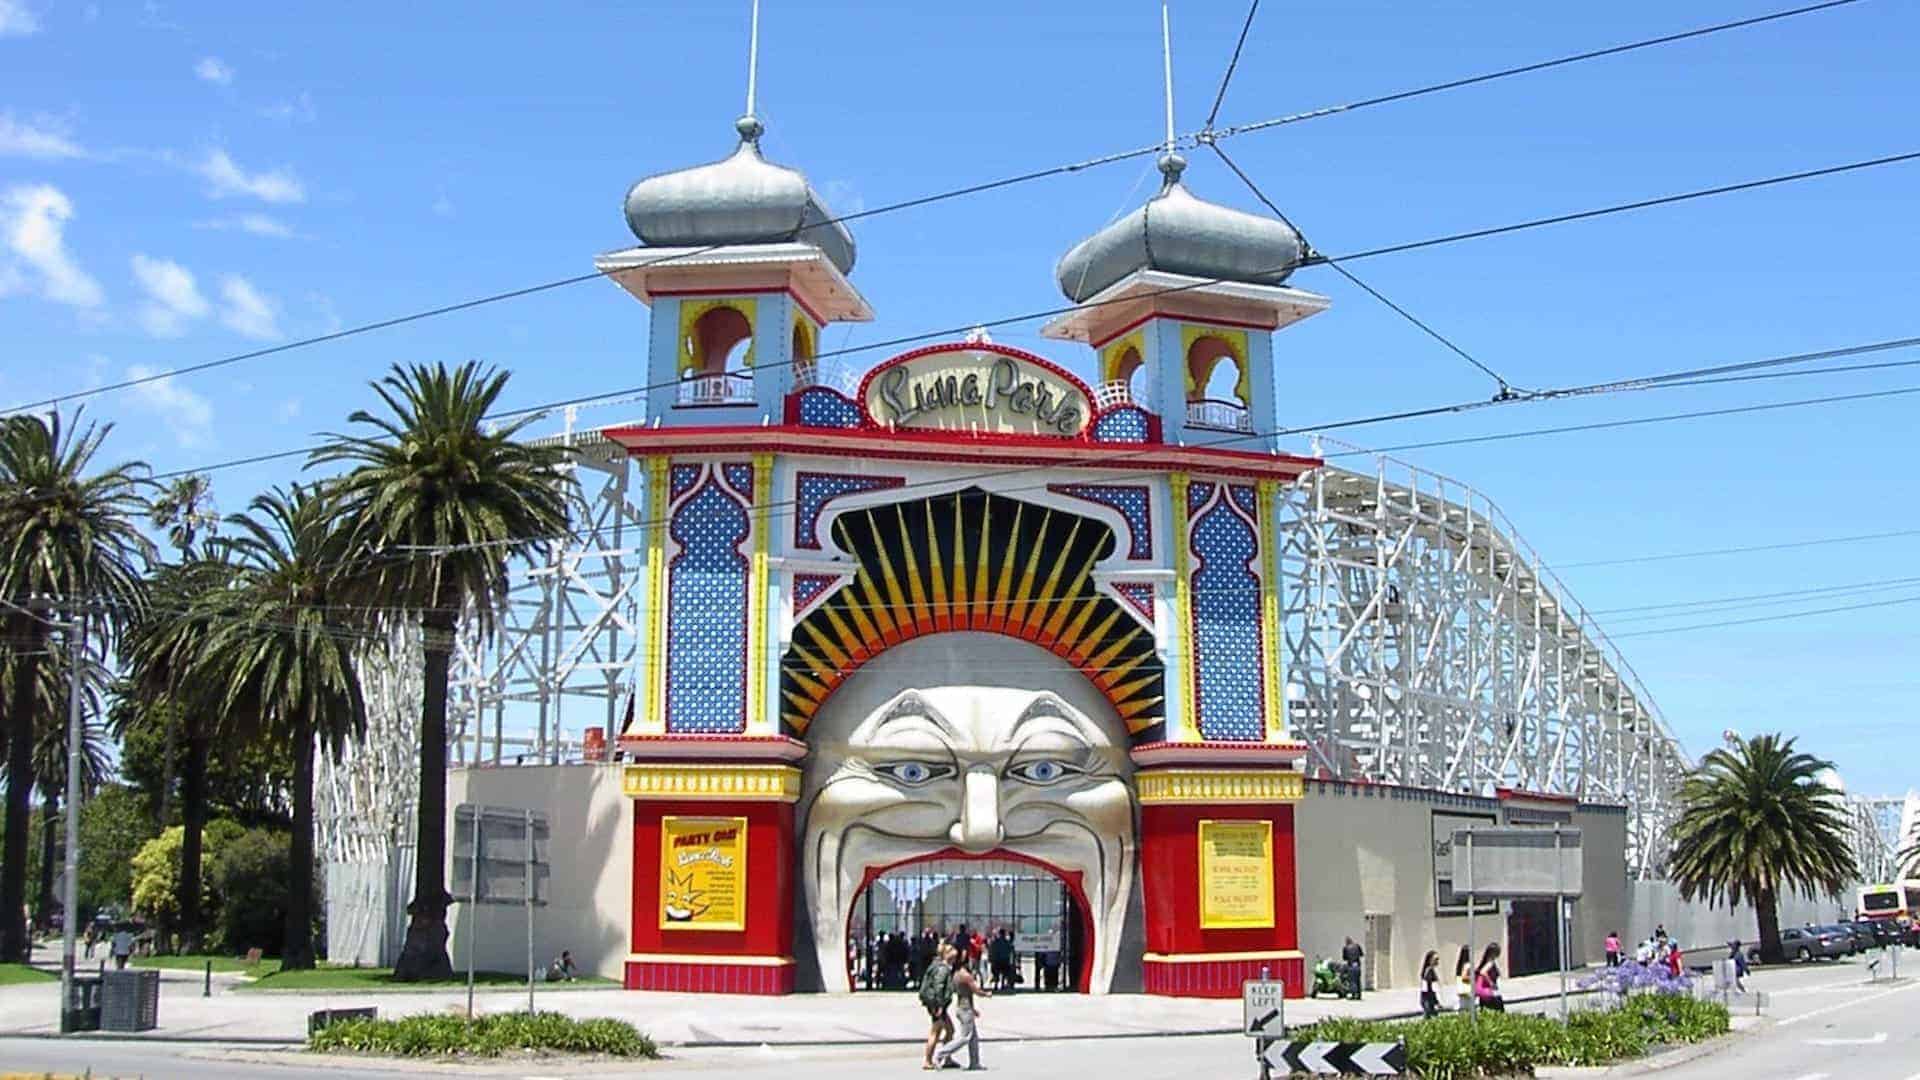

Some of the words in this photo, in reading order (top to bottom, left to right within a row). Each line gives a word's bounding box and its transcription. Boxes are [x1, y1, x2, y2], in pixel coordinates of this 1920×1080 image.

[880, 365, 982, 425] Luna
[985, 357, 1082, 433] Park
[673, 832, 711, 848] PARTY
[1251, 986, 1277, 995] KEEP
[1252, 997, 1277, 1007] LEFT
